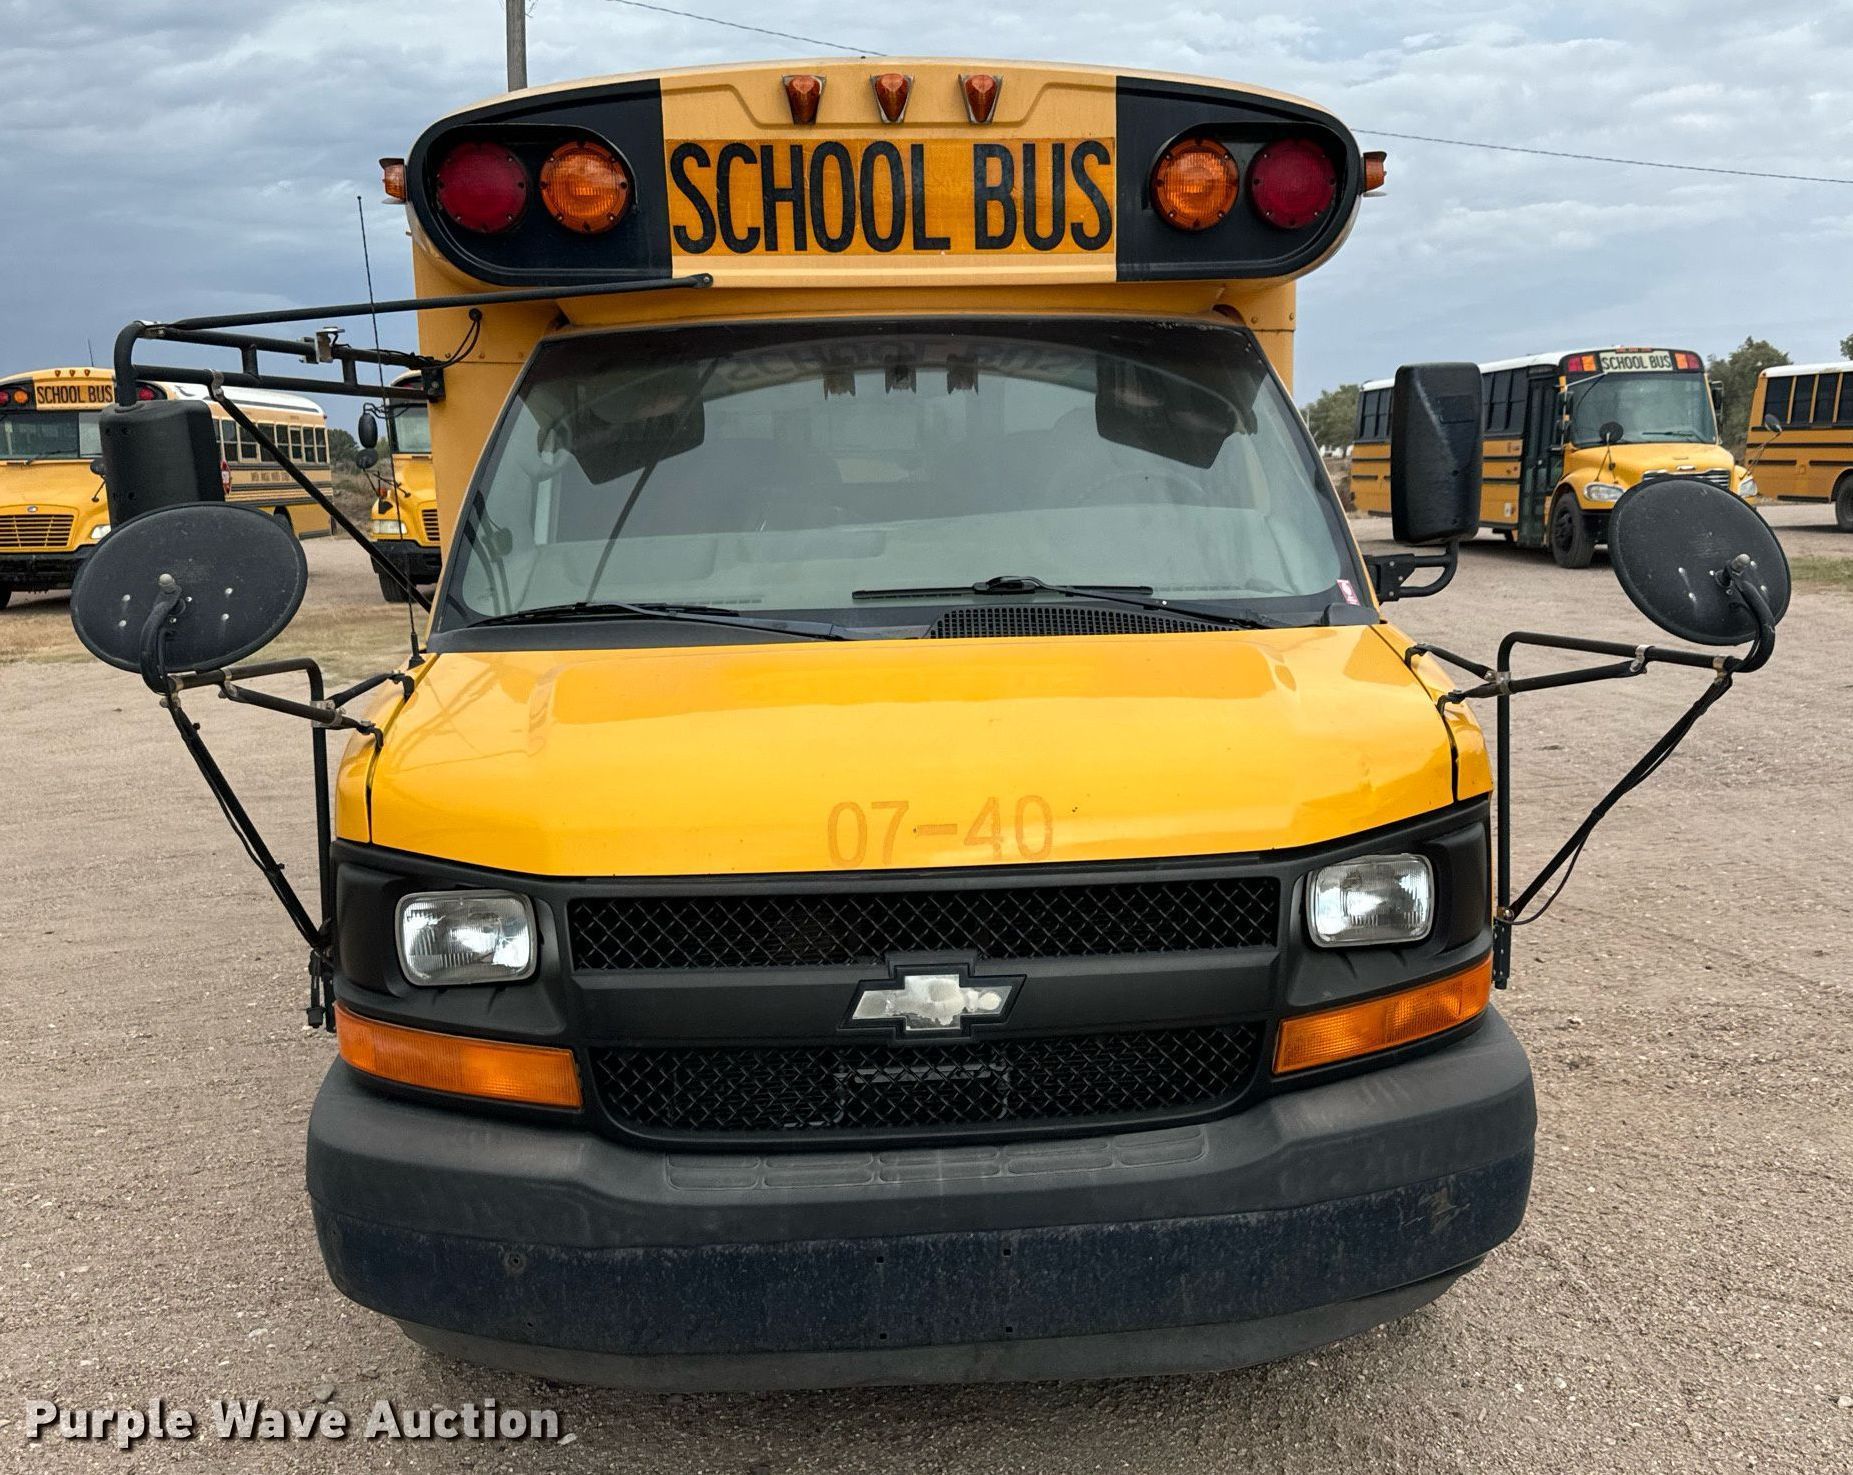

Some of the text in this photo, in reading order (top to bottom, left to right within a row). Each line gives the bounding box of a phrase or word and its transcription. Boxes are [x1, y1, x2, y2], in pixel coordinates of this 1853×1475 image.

[670, 140, 1113, 254] SCHOOL BUS
[1602, 354, 1672, 371] SCHOOL BUS
[36, 384, 114, 404] SCHOOL BUS
[828, 794, 1054, 868] 07-40
